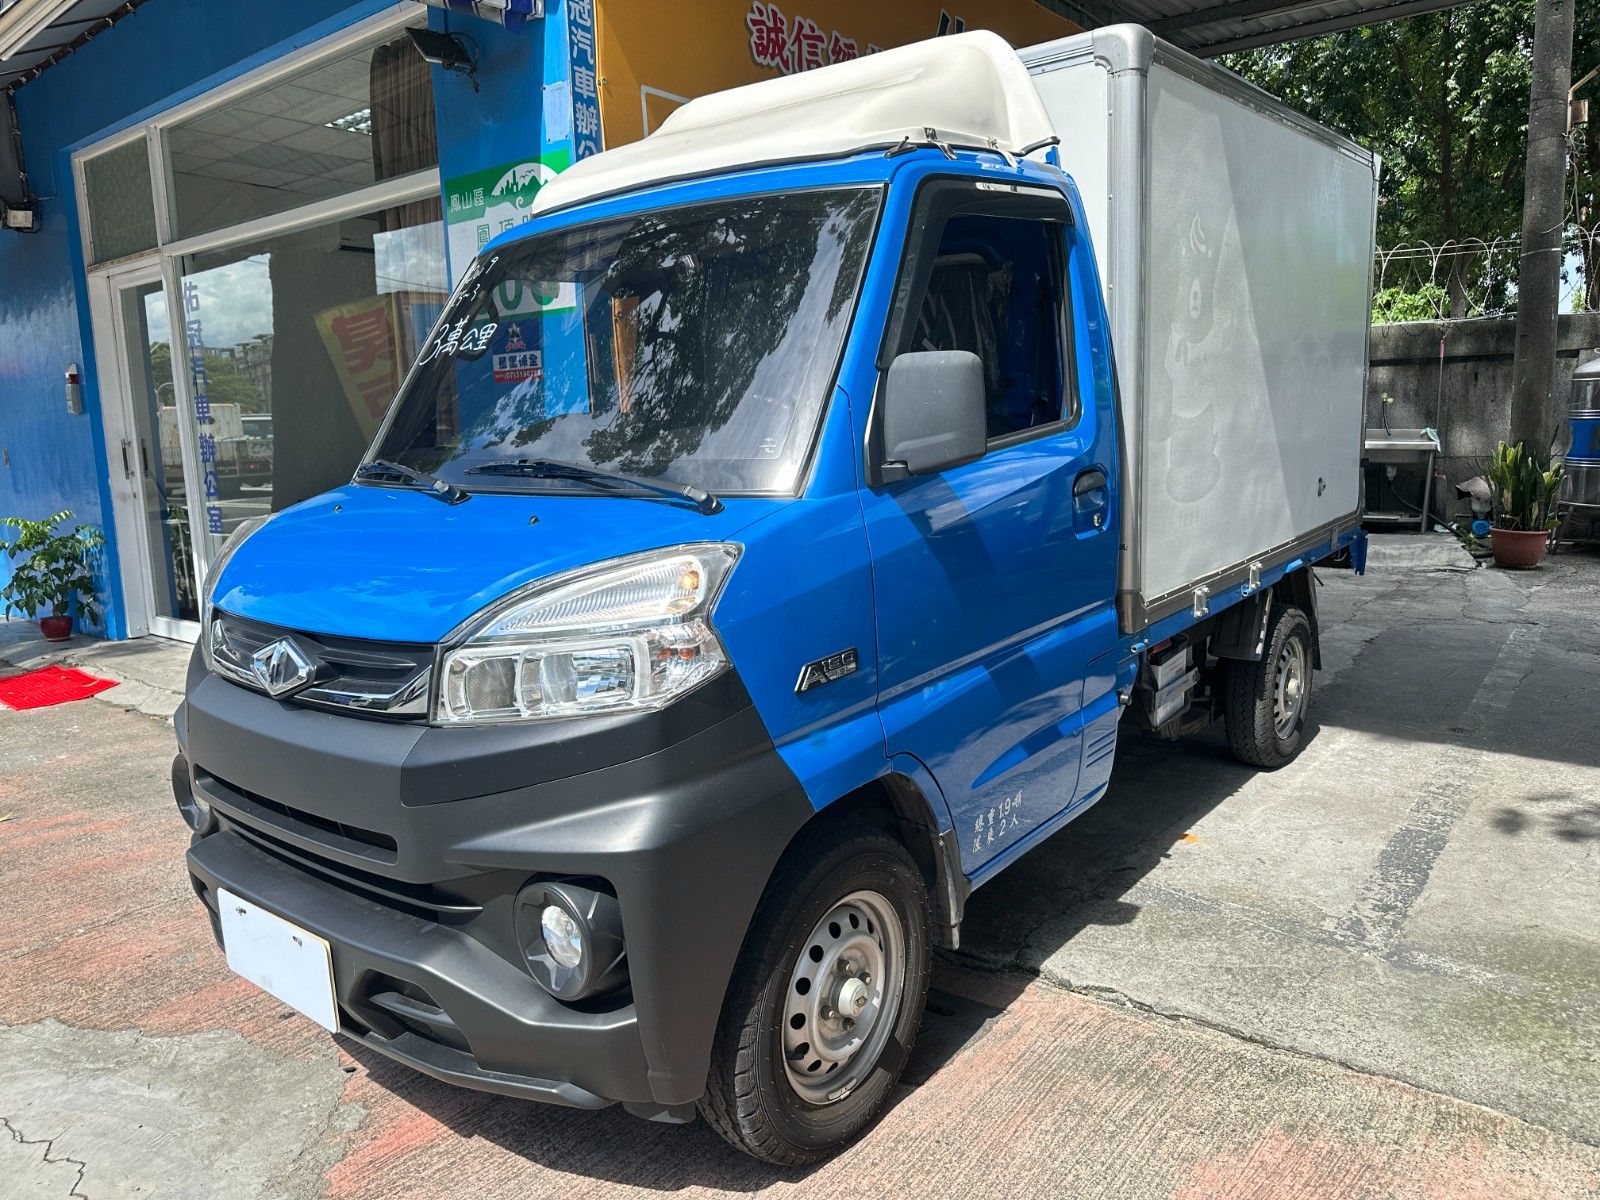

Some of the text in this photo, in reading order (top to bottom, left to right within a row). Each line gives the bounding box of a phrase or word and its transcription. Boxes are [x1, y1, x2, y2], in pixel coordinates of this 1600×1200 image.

[451, 187, 485, 213] 鳳山區
[183, 280, 222, 534] 佑冠汽車辦公室
